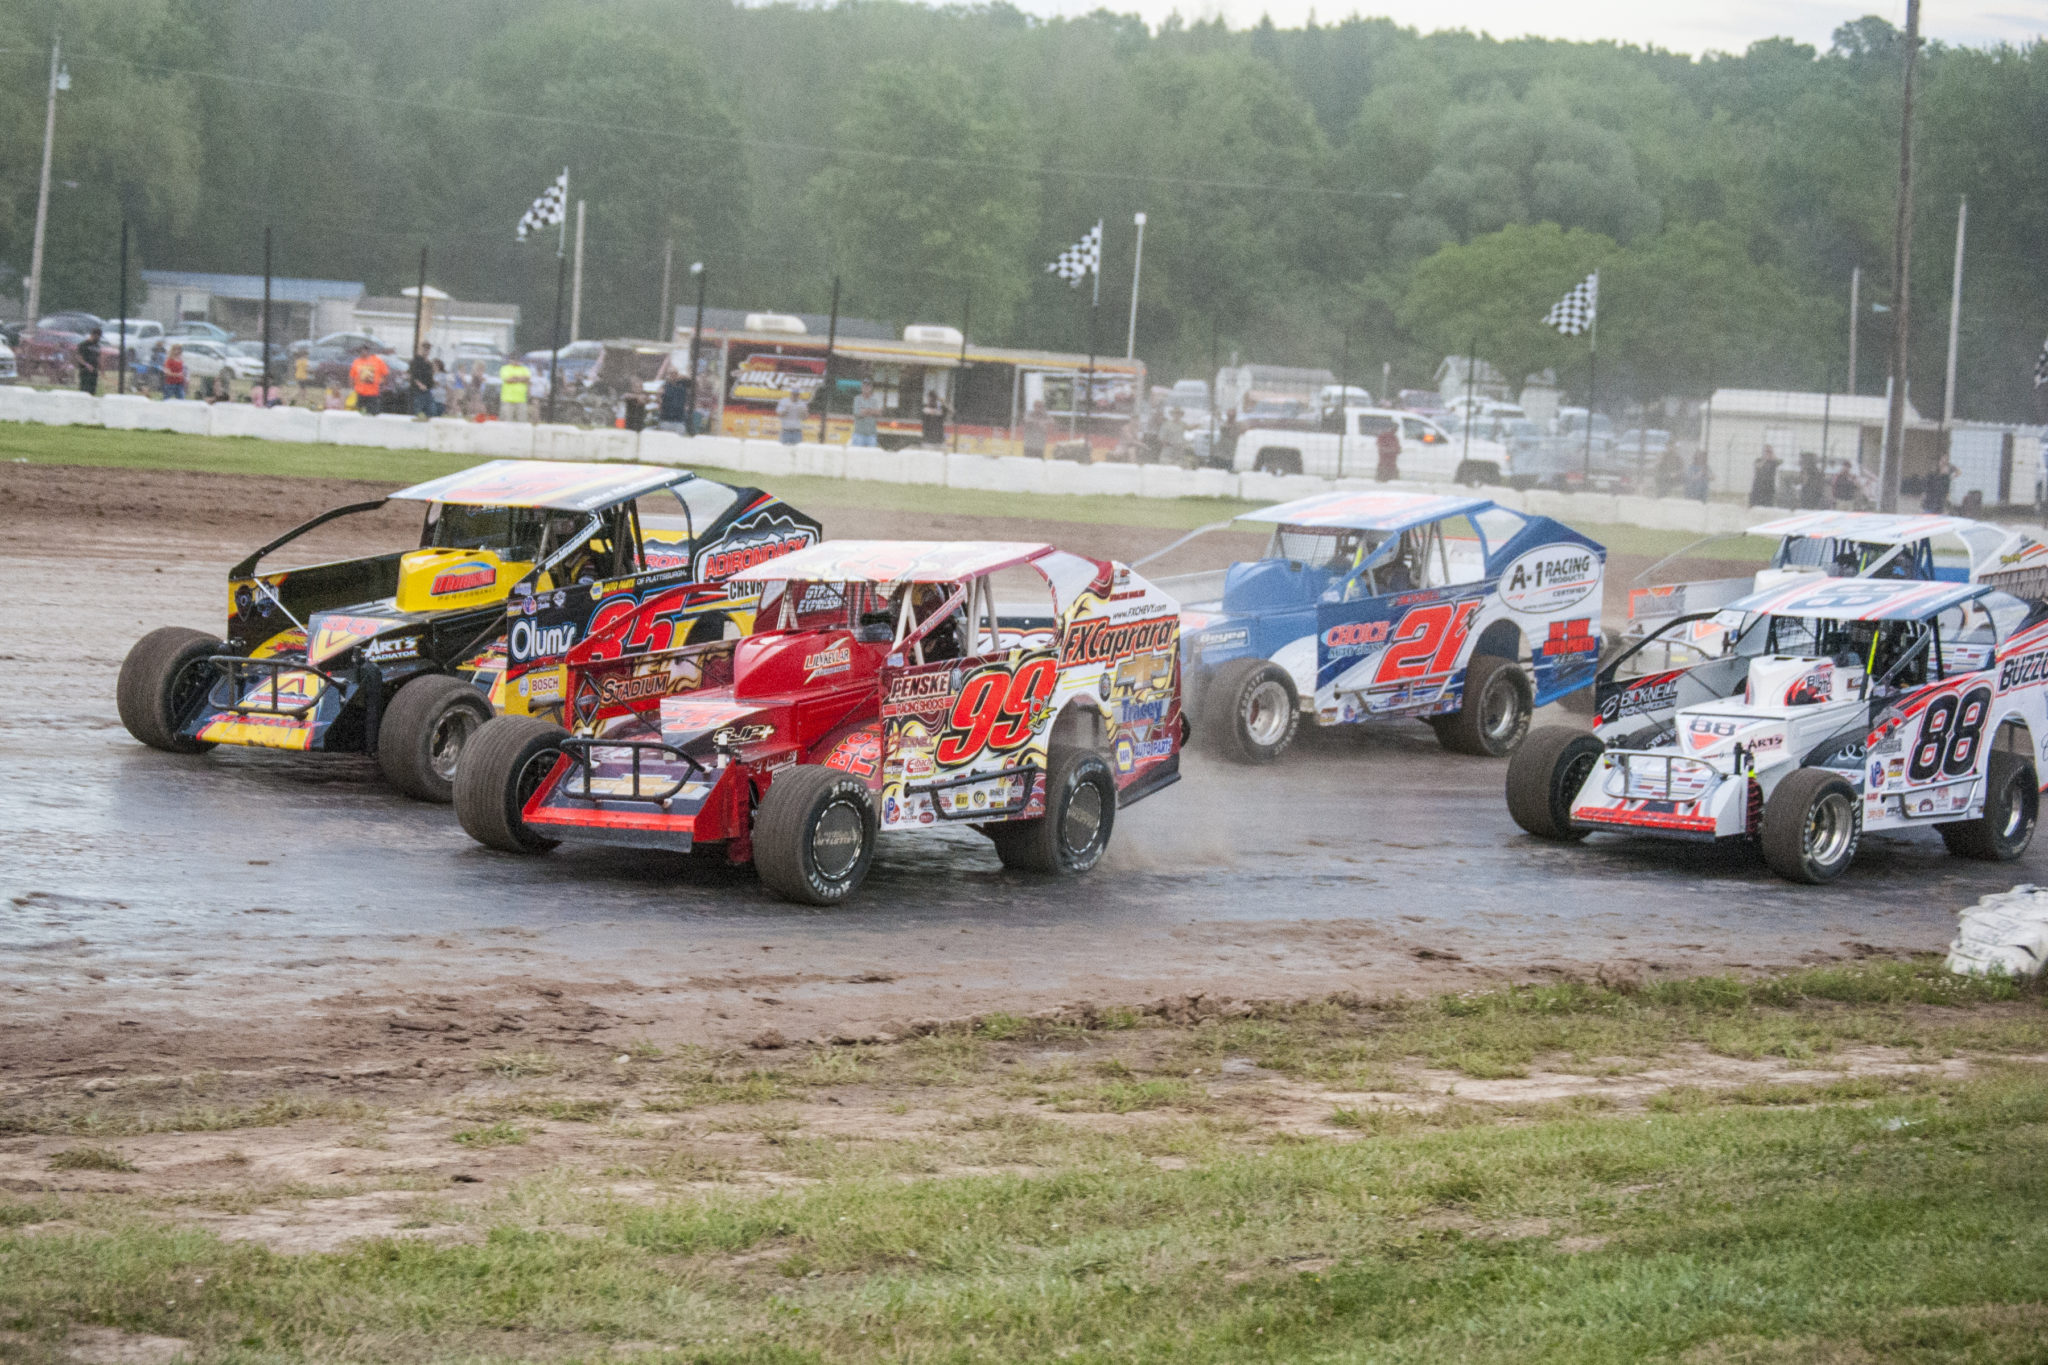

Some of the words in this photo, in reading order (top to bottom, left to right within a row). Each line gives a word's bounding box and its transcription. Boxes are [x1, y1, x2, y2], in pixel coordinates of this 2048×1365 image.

[705, 534, 809, 578] ADIRONDACK
[1509, 562, 1544, 591] A-1
[1545, 555, 1591, 577] RACING
[1549, 573, 1586, 584] PRODUCTS
[1552, 586, 1588, 598] CERTIFIED
[511, 618, 577, 662] Olum's
[1060, 619, 1175, 664] FXCaprara
[1327, 621, 1391, 647] CHOICE
[532, 677, 559, 692] BOSCH
[602, 675, 669, 703] STADIUM
[889, 672, 949, 700] PENSKE
[936, 658, 1060, 763] 99
[1122, 699, 1163, 724] Tracey
[1689, 719, 1736, 737] 88
[1908, 686, 1992, 781] 88
